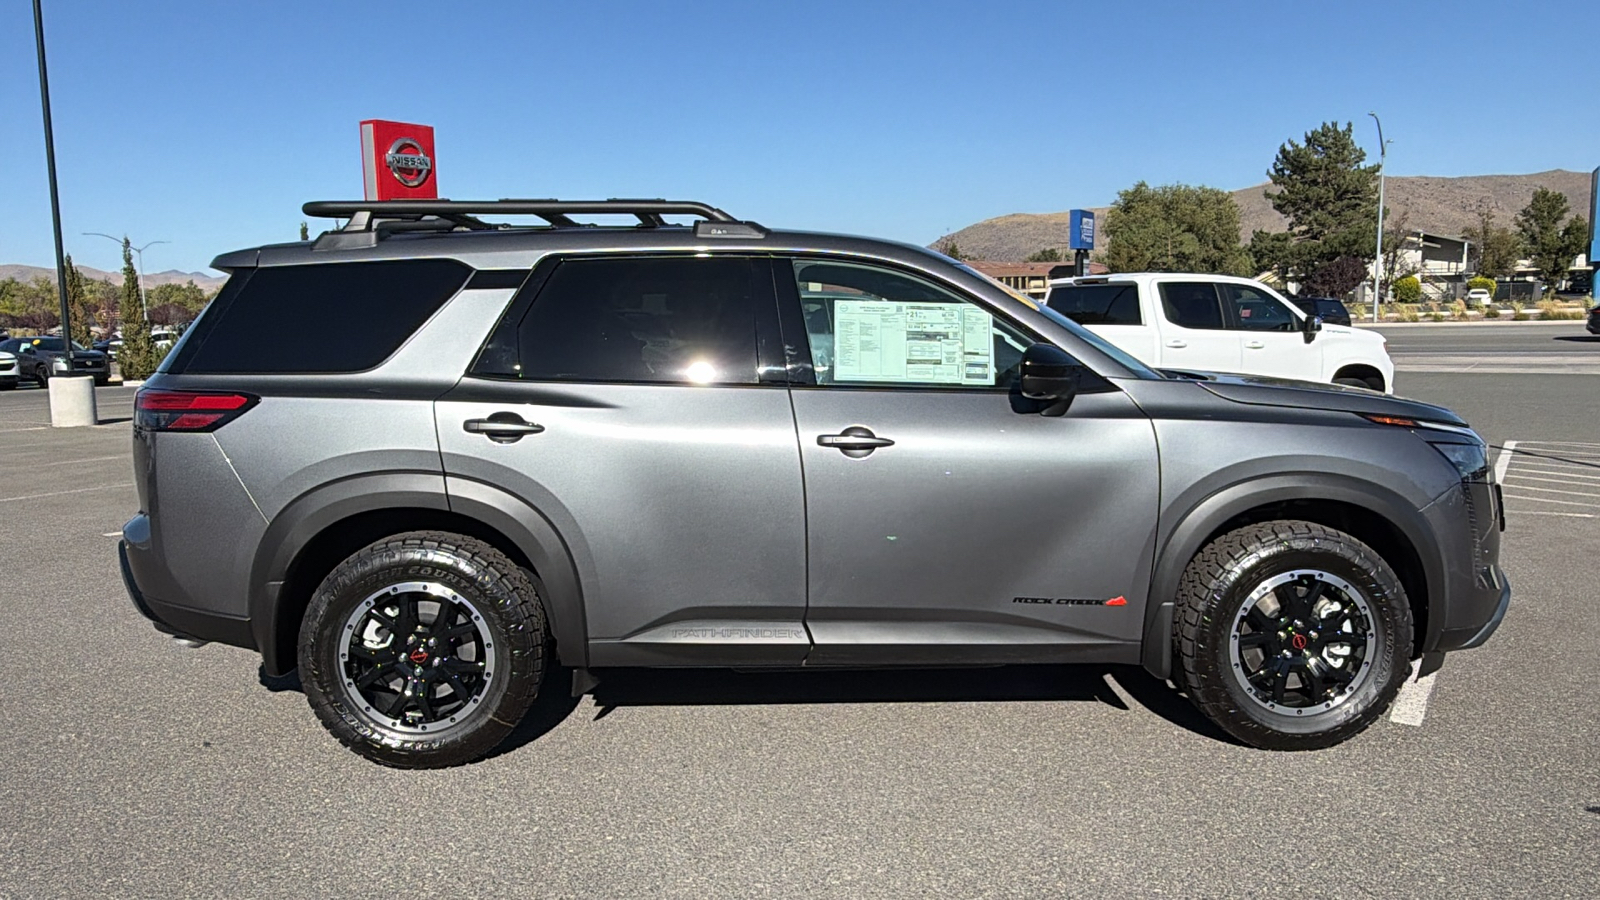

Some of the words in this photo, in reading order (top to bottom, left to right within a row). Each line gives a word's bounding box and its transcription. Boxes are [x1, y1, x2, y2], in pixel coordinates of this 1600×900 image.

[391, 156, 429, 167] NISSAN
[1056, 598, 1105, 606] CREEK
[671, 627, 803, 639] PATHFINDER
